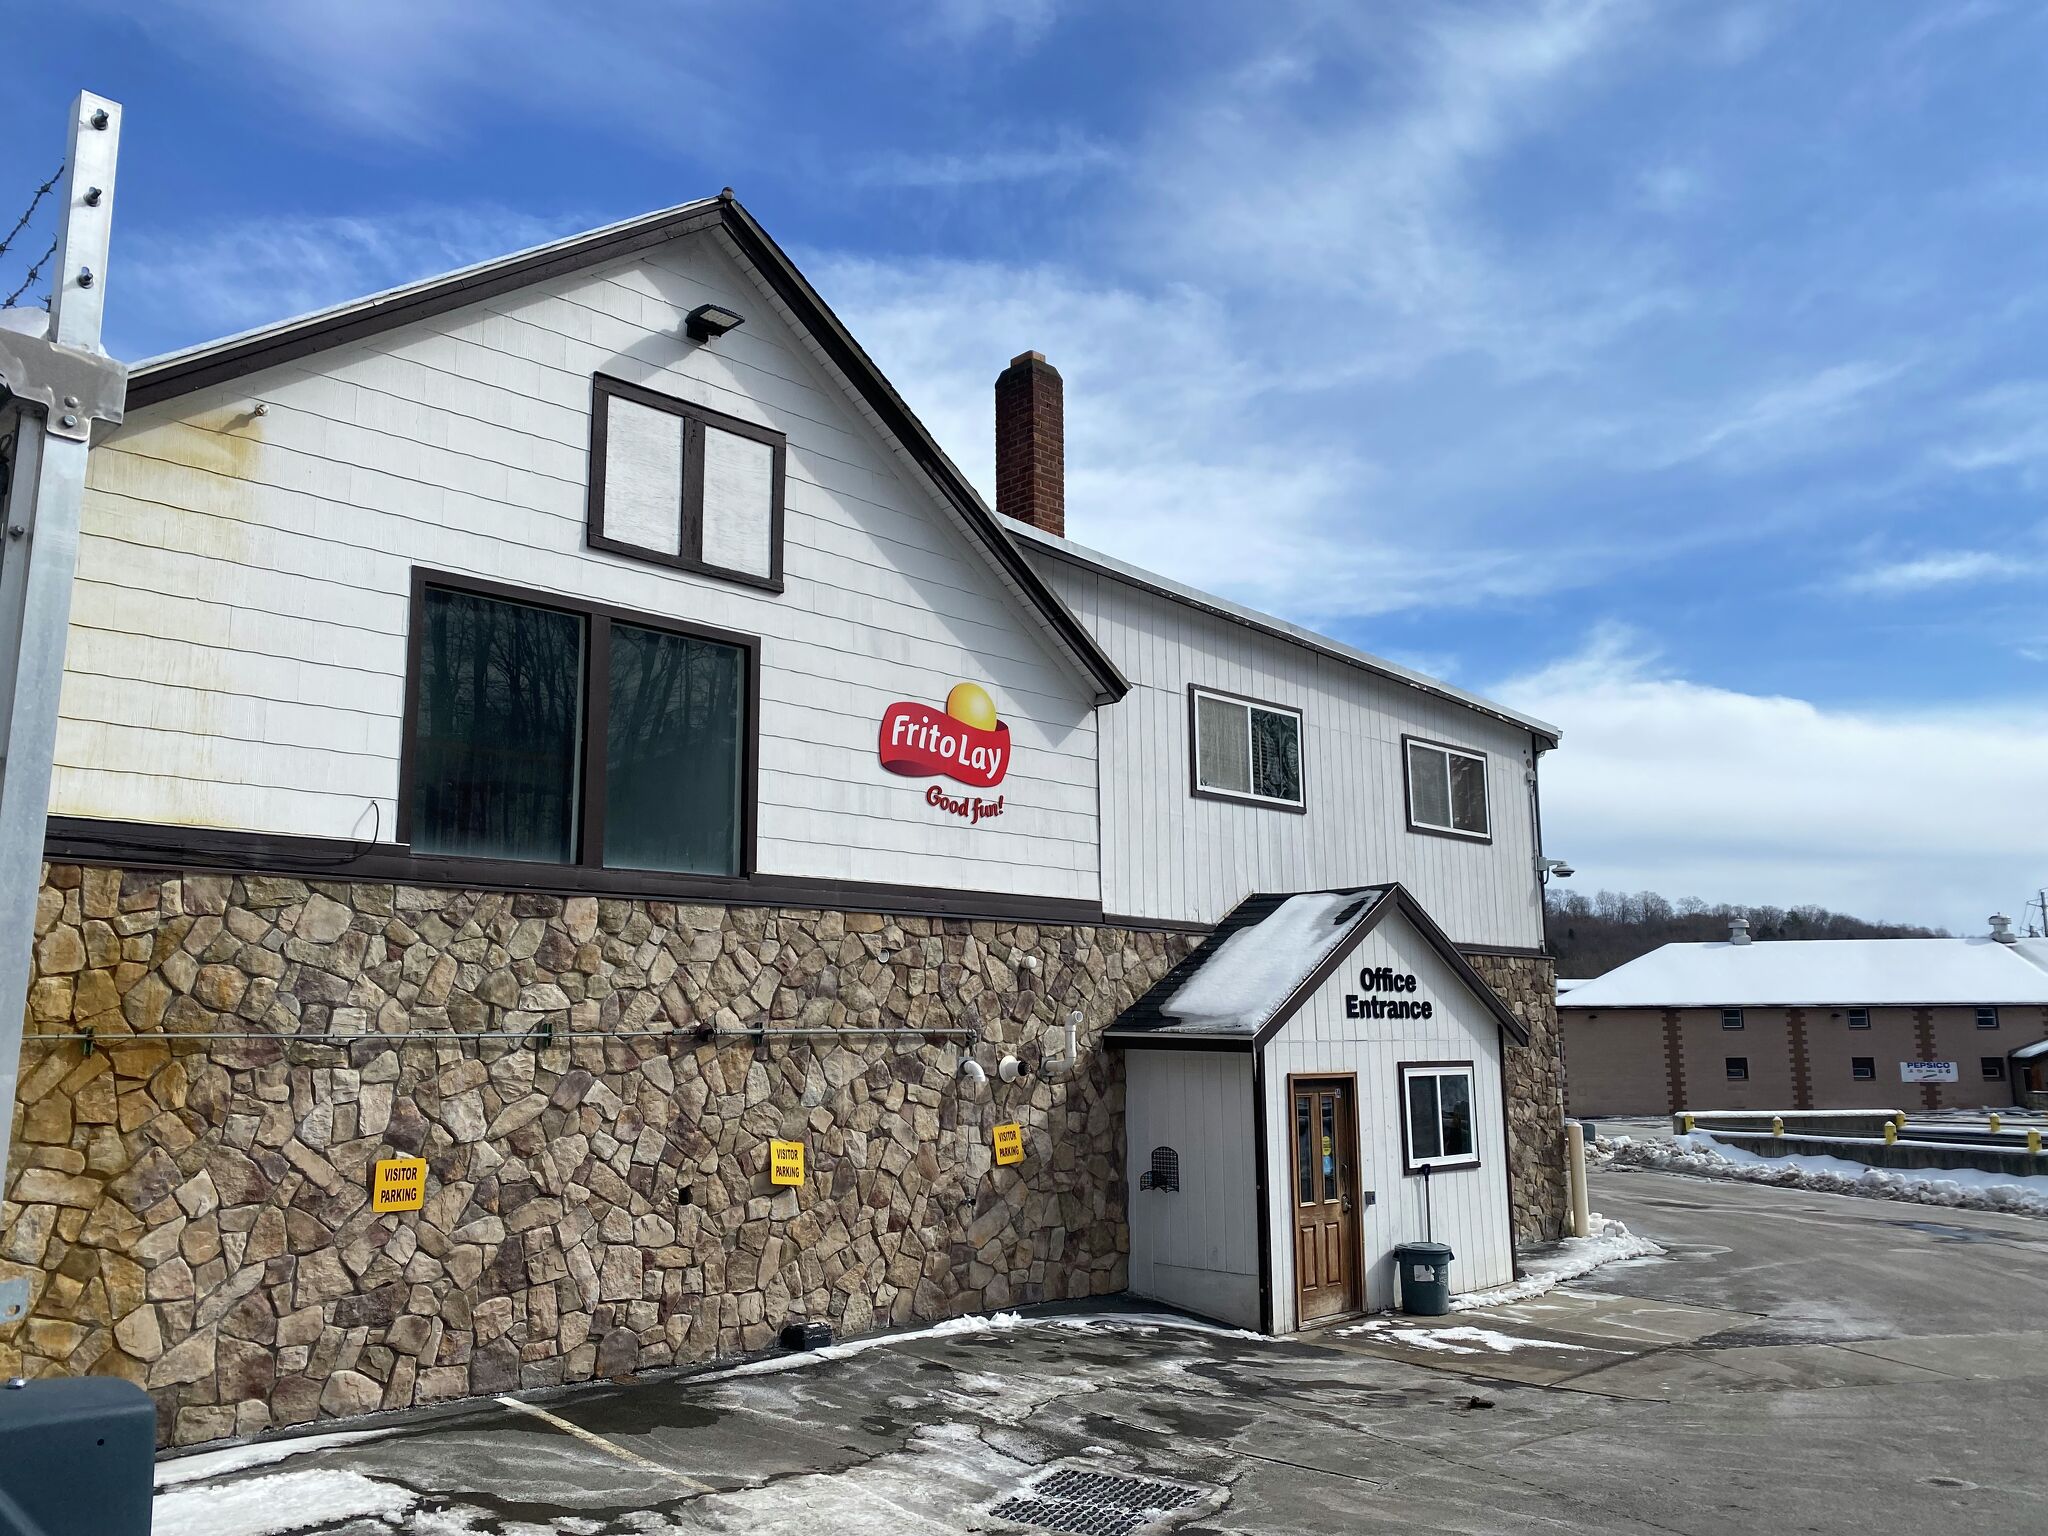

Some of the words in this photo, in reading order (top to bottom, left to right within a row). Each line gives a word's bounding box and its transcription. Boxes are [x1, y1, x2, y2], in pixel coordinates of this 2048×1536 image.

[926, 785, 970, 817] Good
[970, 795, 1004, 825] fun!
[1360, 967, 1417, 993] Office
[1345, 994, 1433, 1020] Entrance
[998, 1130, 1017, 1142] VISITOR
[776, 1148, 799, 1160] VISITOR
[999, 1145, 1020, 1158] PARKING
[384, 1167, 418, 1182] VISITOR
[775, 1165, 800, 1178] PARKING
[380, 1187, 418, 1204] PARKING
